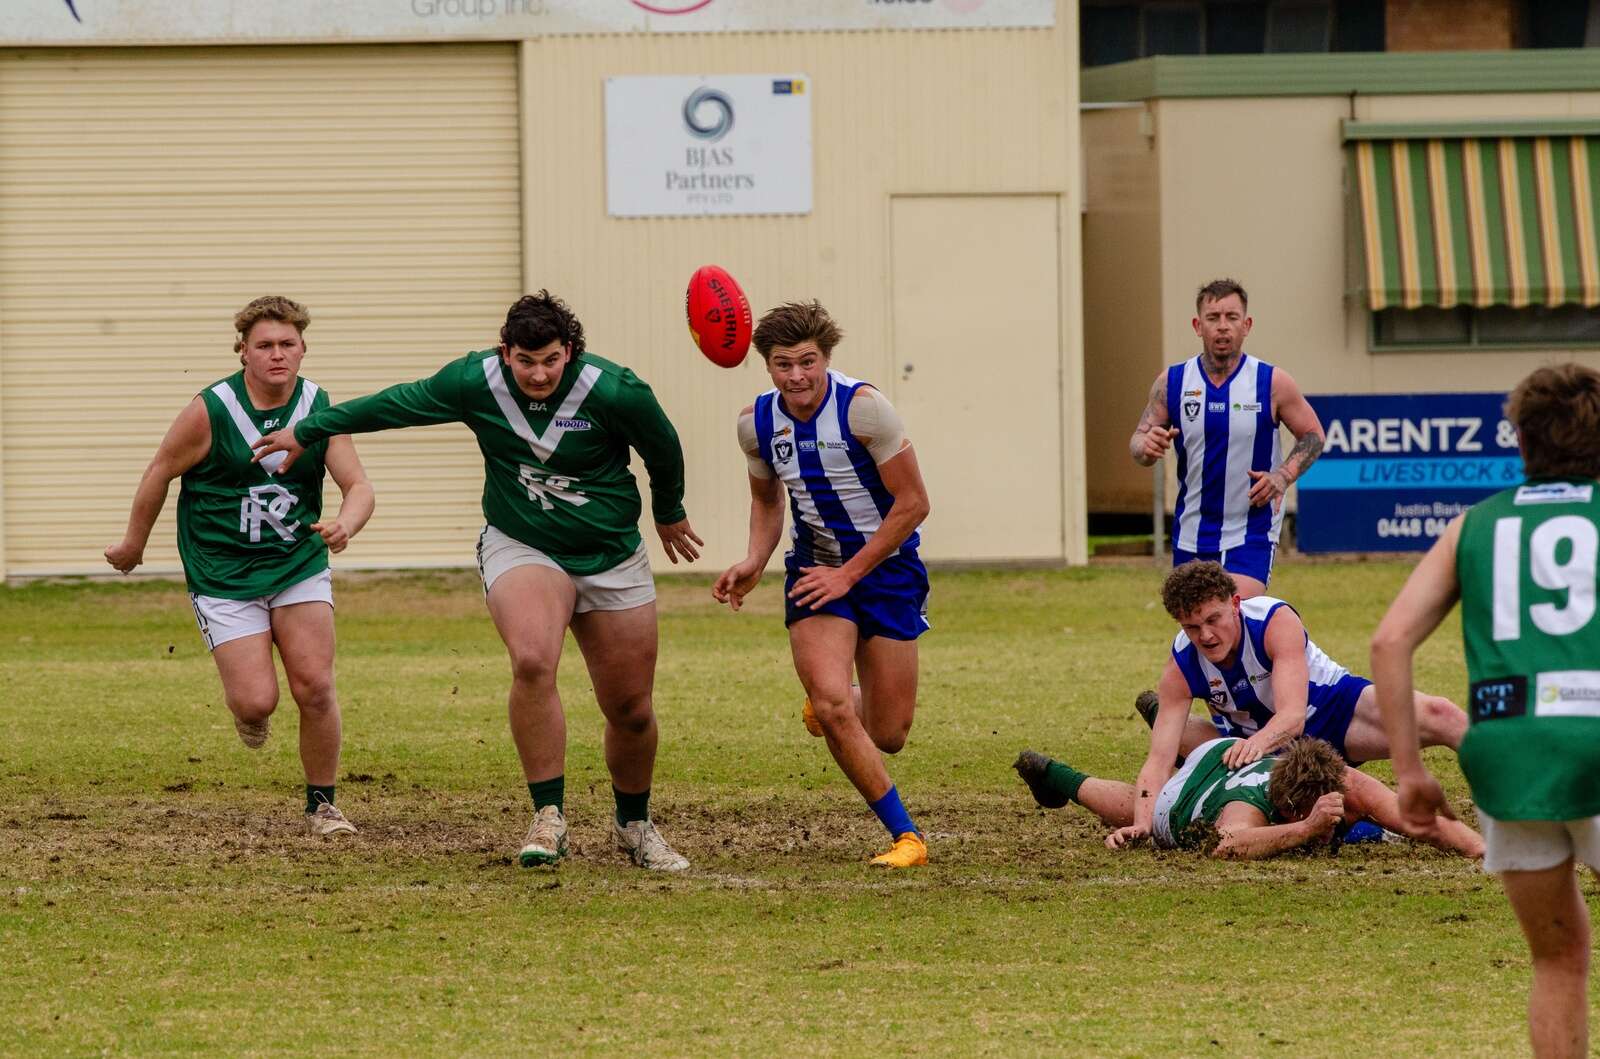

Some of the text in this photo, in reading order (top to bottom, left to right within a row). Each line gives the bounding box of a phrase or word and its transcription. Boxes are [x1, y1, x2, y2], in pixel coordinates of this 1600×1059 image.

[411, 0, 497, 23] Group
[665, 171, 755, 190] Partners
[707, 278, 737, 351] SHERRIN
[554, 419, 589, 428] WOODS
[1495, 420, 1519, 448] &
[1359, 461, 1516, 483] LIVESTOCK &
[1395, 503, 1432, 517] Justin
[1377, 518, 1422, 538] 0448
[1492, 515, 1599, 641] 19
